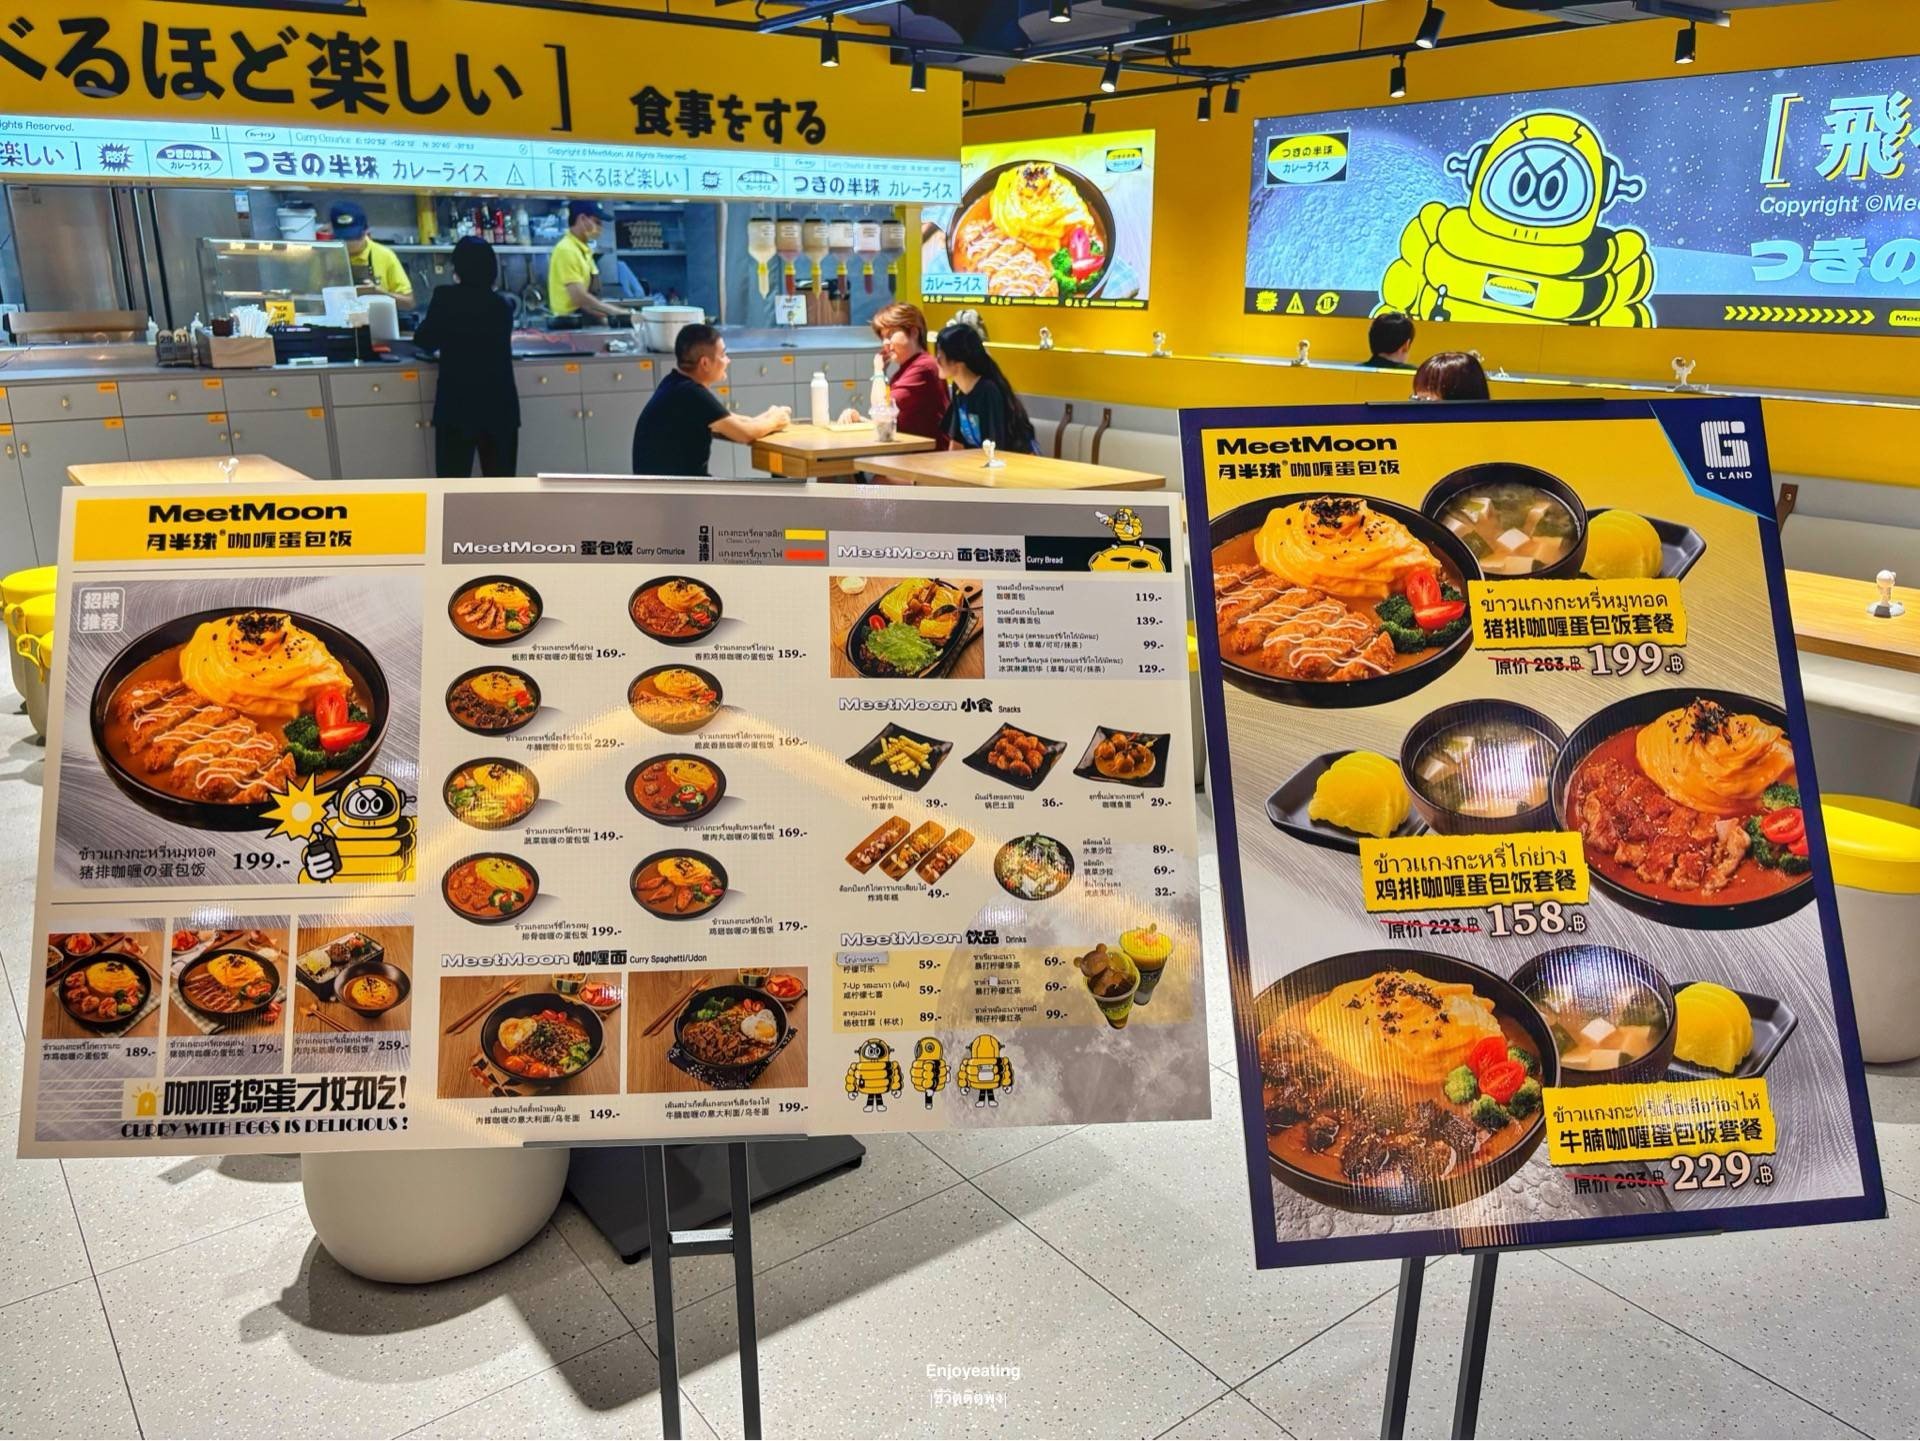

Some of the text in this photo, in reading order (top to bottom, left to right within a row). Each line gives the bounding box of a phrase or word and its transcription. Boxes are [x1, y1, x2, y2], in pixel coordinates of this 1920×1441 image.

[630, 85, 826, 145] 食事をする
[26, 120, 74, 131] Reserved.
[244, 151, 488, 183] つきの半球 カレーライス
[1283, 160, 1330, 174] カレーライス
[794, 176, 880, 196] つきの半球
[888, 180, 953, 199] カレーライス
[1760, 196, 1858, 216] Copyright
[1750, 237, 1920, 285] つきの
[925, 275, 982, 292] カレーライス
[1217, 436, 1397, 455] MeetMoon
[1706, 471, 1753, 480] G LAND
[149, 503, 347, 523] MeetMoon
[453, 541, 686, 557] MeetMoon 蛋包饭 Curry Omurice
[838, 545, 1063, 565] MeetMoon 面包诱惑 Curry Bread
[83, 592, 120, 609] 招牌
[1136, 593, 1162, 602] 119.-
[1481, 586, 1668, 613] ข้าวแกงกะหรี่หมูทอด
[82, 613, 120, 631] 推荐
[1136, 616, 1163, 625] 139.-
[1483, 613, 1675, 640] 猪排咖喱蛋包饭套餐
[1143, 640, 1164, 650] 99.-
[596, 648, 626, 658] 169.-
[778, 649, 807, 659] 159.-
[1138, 664, 1165, 673] 129.-
[1495, 657, 1528, 676] 原价
[839, 697, 1021, 714] MeetMoon 小食 Snacks
[594, 738, 625, 748] 229.-
[779, 737, 807, 746] 169.-
[926, 798, 948, 808] 39.-
[1042, 798, 1063, 808] 36.-
[1151, 797, 1172, 807] 29.-
[593, 831, 624, 841] 149.-
[778, 827, 808, 838] 169.-
[79, 841, 216, 862] ข้าวแกงกะหรี่หมูทอด
[1152, 844, 1174, 854] 89.-
[232, 852, 290, 870] 199.-
[1373, 842, 1566, 874] ข้าวแกงกะหรี่ไก่ย่าง
[79, 862, 206, 880] 猪排咖喱の蛋包饭
[1153, 865, 1175, 875] 69.-
[1376, 868, 1577, 900] 鸡排咖喱蛋包饭套餐
[927, 888, 950, 899] 49.-
[1154, 887, 1176, 897] 32.-
[592, 926, 622, 936] 199.-
[778, 921, 808, 931] 179.-
[1388, 920, 1423, 939] 原价
[841, 929, 1027, 947] MeetMoon 饮品 Drinks
[441, 950, 707, 968] MeetMoon 咖喱面 Curry Spaghetti/Udon
[919, 959, 941, 969] 59.-
[1044, 956, 1066, 967] 69.-
[842, 982, 861, 990] 7-Up
[919, 985, 941, 995] 59.-
[1045, 981, 1067, 992] 69.-
[919, 1012, 942, 1022] 89.-
[1046, 1009, 1068, 1020] 99.-
[252, 1043, 282, 1054] 179.-
[378, 1040, 409, 1051] 259.-
[125, 1046, 156, 1057] 189.-
[778, 1101, 809, 1113] 199.-
[589, 1108, 620, 1120] 149.-
[121, 1122, 178, 1138] CURRY
[184, 1121, 231, 1137] WITH
[235, 1119, 280, 1134] EGGS
[284, 1118, 300, 1133] IS
[305, 1116, 398, 1133] DELICIOUS
[1559, 1117, 1763, 1154] 牛腩咖喱蛋包饭套餐
[1574, 1174, 1609, 1195] 原价
